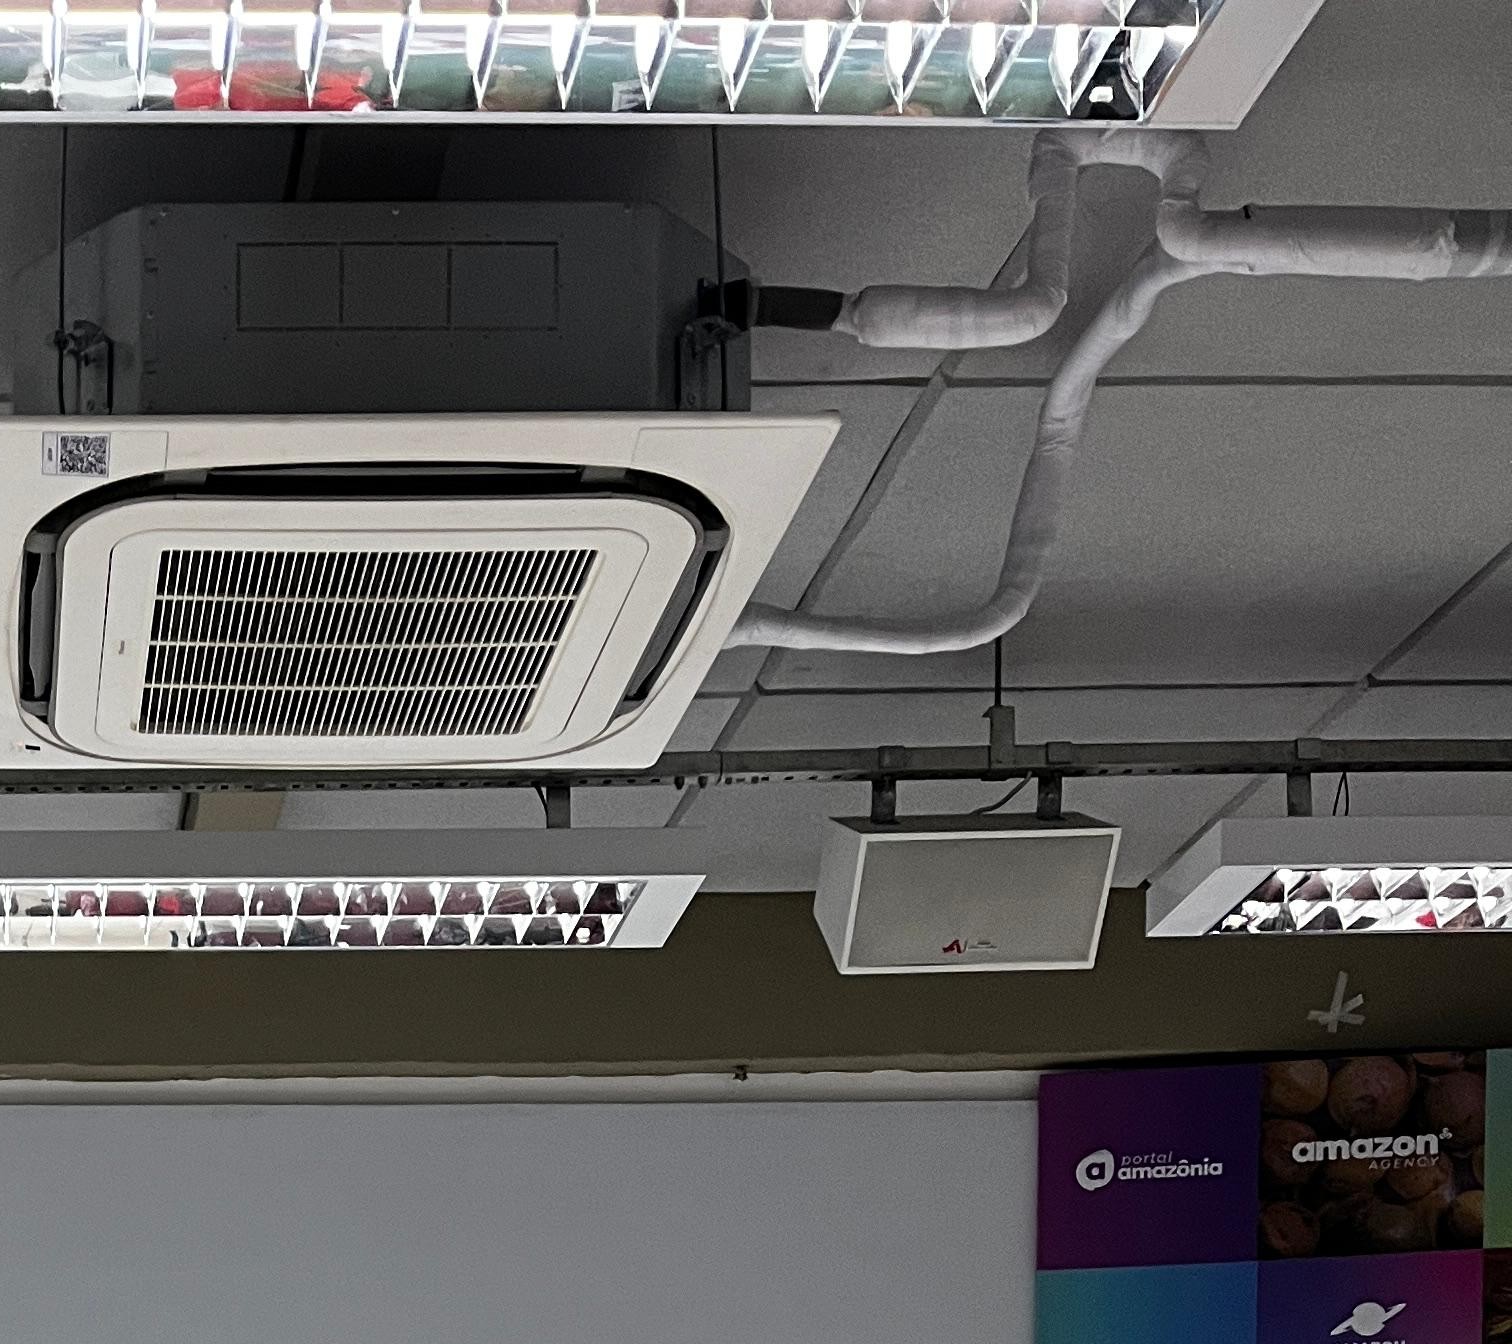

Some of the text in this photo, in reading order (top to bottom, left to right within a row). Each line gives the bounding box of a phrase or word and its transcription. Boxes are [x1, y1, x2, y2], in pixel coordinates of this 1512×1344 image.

[1292, 1133, 1439, 1163] amazon
[1121, 1151, 1173, 1166] portal
[1368, 1156, 1440, 1170] AGENCY
[1117, 1157, 1223, 1180] amazônia
